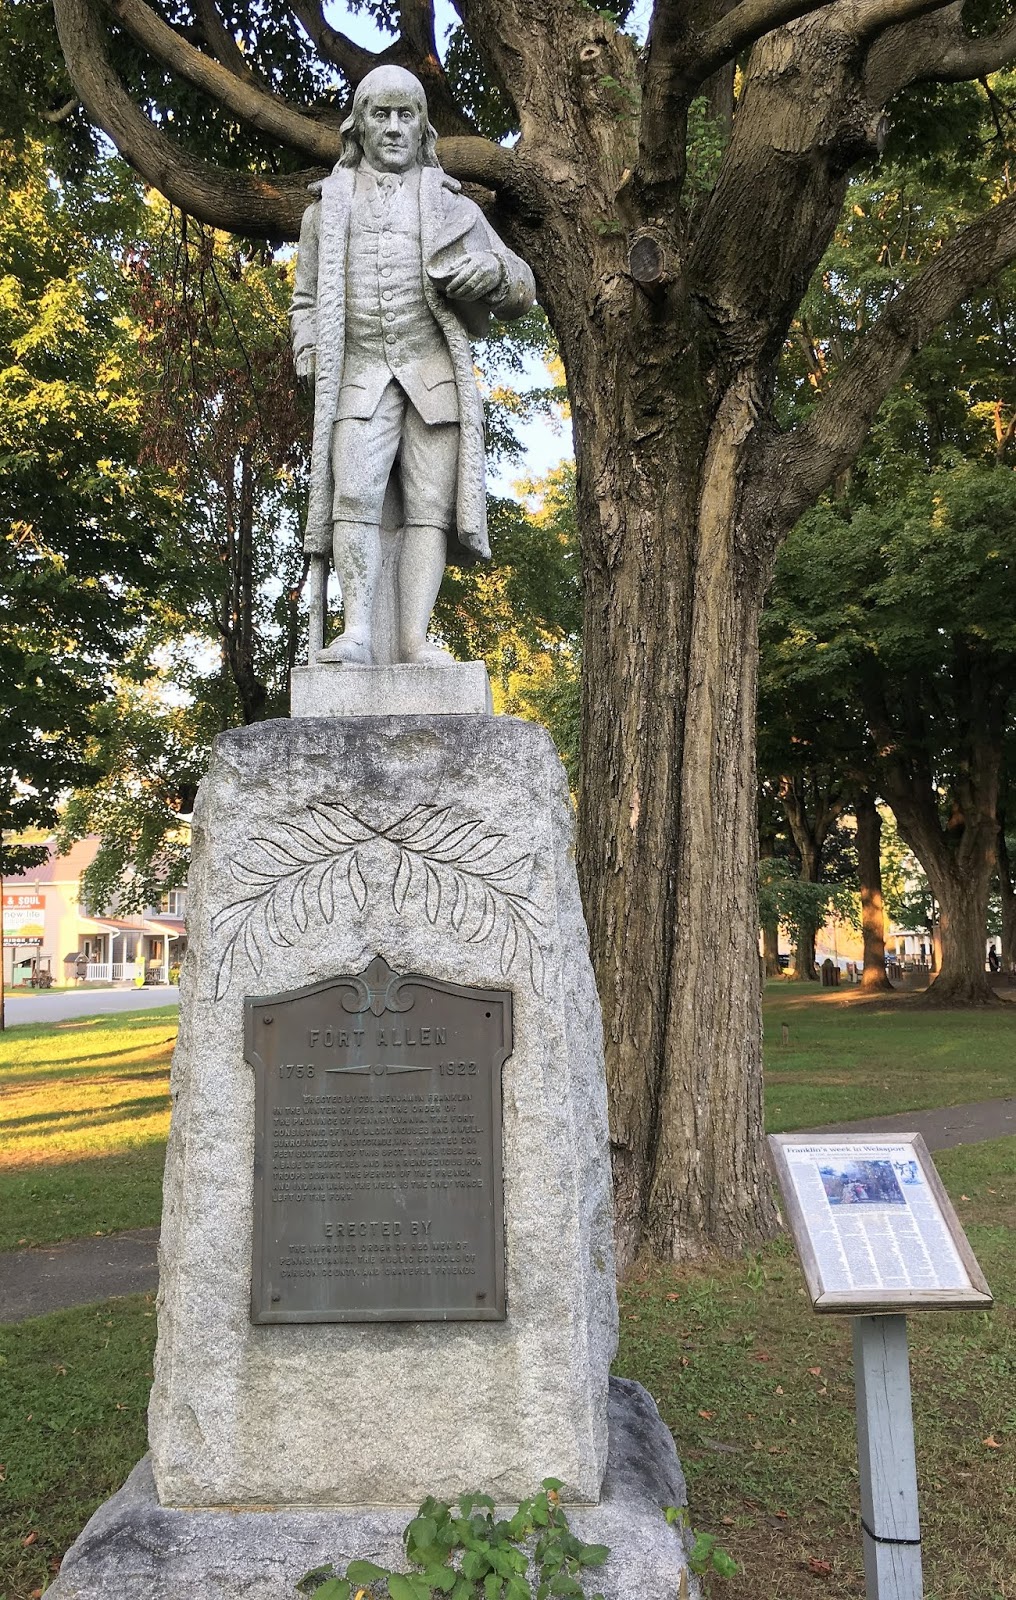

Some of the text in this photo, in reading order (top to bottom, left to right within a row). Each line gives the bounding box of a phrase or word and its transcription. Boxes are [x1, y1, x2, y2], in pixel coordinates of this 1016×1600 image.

[7, 896, 40, 905] & SOUL
[309, 1027, 448, 1047] FORT ALLEN
[279, 1061, 479, 1079] 1756 1922
[303, 1094, 343, 1104] ERECTED
[345, 1094, 356, 1104] BY
[379, 1094, 424, 1103] BENJAMIN
[428, 1093, 472, 1103] FRANKLIN
[273, 1106, 282, 1115] IN
[285, 1106, 301, 1115] THE
[303, 1106, 337, 1115] WINTER
[340, 1106, 351, 1115] OF
[377, 1105, 389, 1114] AT
[391, 1104, 408, 1114] THE
[412, 1103, 440, 1113] ORDER
[445, 1103, 456, 1112] OF
[273, 1116, 290, 1126] THE
[293, 1116, 338, 1126] PROVINCE
[340, 1116, 352, 1125] OF
[430, 1114, 448, 1124] THE
[451, 1113, 475, 1123] FORT
[273, 1127, 326, 1137] CONSISTING
[329, 1127, 340, 1136] OF
[341, 1127, 360, 1136] TWO
[363, 1126, 392, 1136] BLOCK
[395, 1126, 429, 1135] HOUSES
[432, 1125, 449, 1134] AND
[273, 1138, 329, 1148] SURROUNDED
[331, 1138, 342, 1147] BY
[415, 1136, 457, 1145] SITUATED
[273, 1149, 294, 1158] FEET
[296, 1149, 345, 1158] SOUTHWEST
[346, 1148, 357, 1158] OF
[359, 1148, 379, 1157] THIS
[408, 1147, 419, 1156] IT
[420, 1146, 439, 1156] WAS
[441, 1146, 464, 1155] USED
[466, 1146, 478, 1155] AS
[281, 1160, 302, 1169] BASE
[304, 1160, 316, 1169] OF
[317, 1159, 360, 1169] SUPPLIES
[362, 1158, 380, 1168] AND
[382, 1158, 394, 1167] AS
[403, 1157, 462, 1167] RENDEZVOUS
[464, 1156, 482, 1166] FOR
[272, 1168, 472, 1180] TROOPS DURING THE PERIOD OF THE FRENCH
[272, 1182, 290, 1191] AND
[292, 1182, 325, 1191] INDIAN
[354, 1181, 371, 1190] THE
[374, 1180, 397, 1190] WELL
[411, 1179, 428, 1189] THE
[430, 1179, 453, 1188] ONLY
[455, 1178, 483, 1188] TRACE
[272, 1192, 294, 1203] LEFT
[296, 1192, 307, 1202] OF
[309, 1192, 326, 1202] THE
[325, 1220, 433, 1237] ERECTED BY
[288, 1240, 469, 1254] THE IMPROVED ORDER OF RED MEN OF
[357, 1255, 376, 1265] THE
[381, 1254, 414, 1264] PUBLIC
[417, 1253, 461, 1263] SCHOOLS
[465, 1252, 476, 1263] OF
[281, 1269, 317, 1279] CARBON
[362, 1267, 380, 1277] AND
[385, 1266, 432, 1276] GRATEFUL
[435, 1265, 476, 1275] FRIENDS
